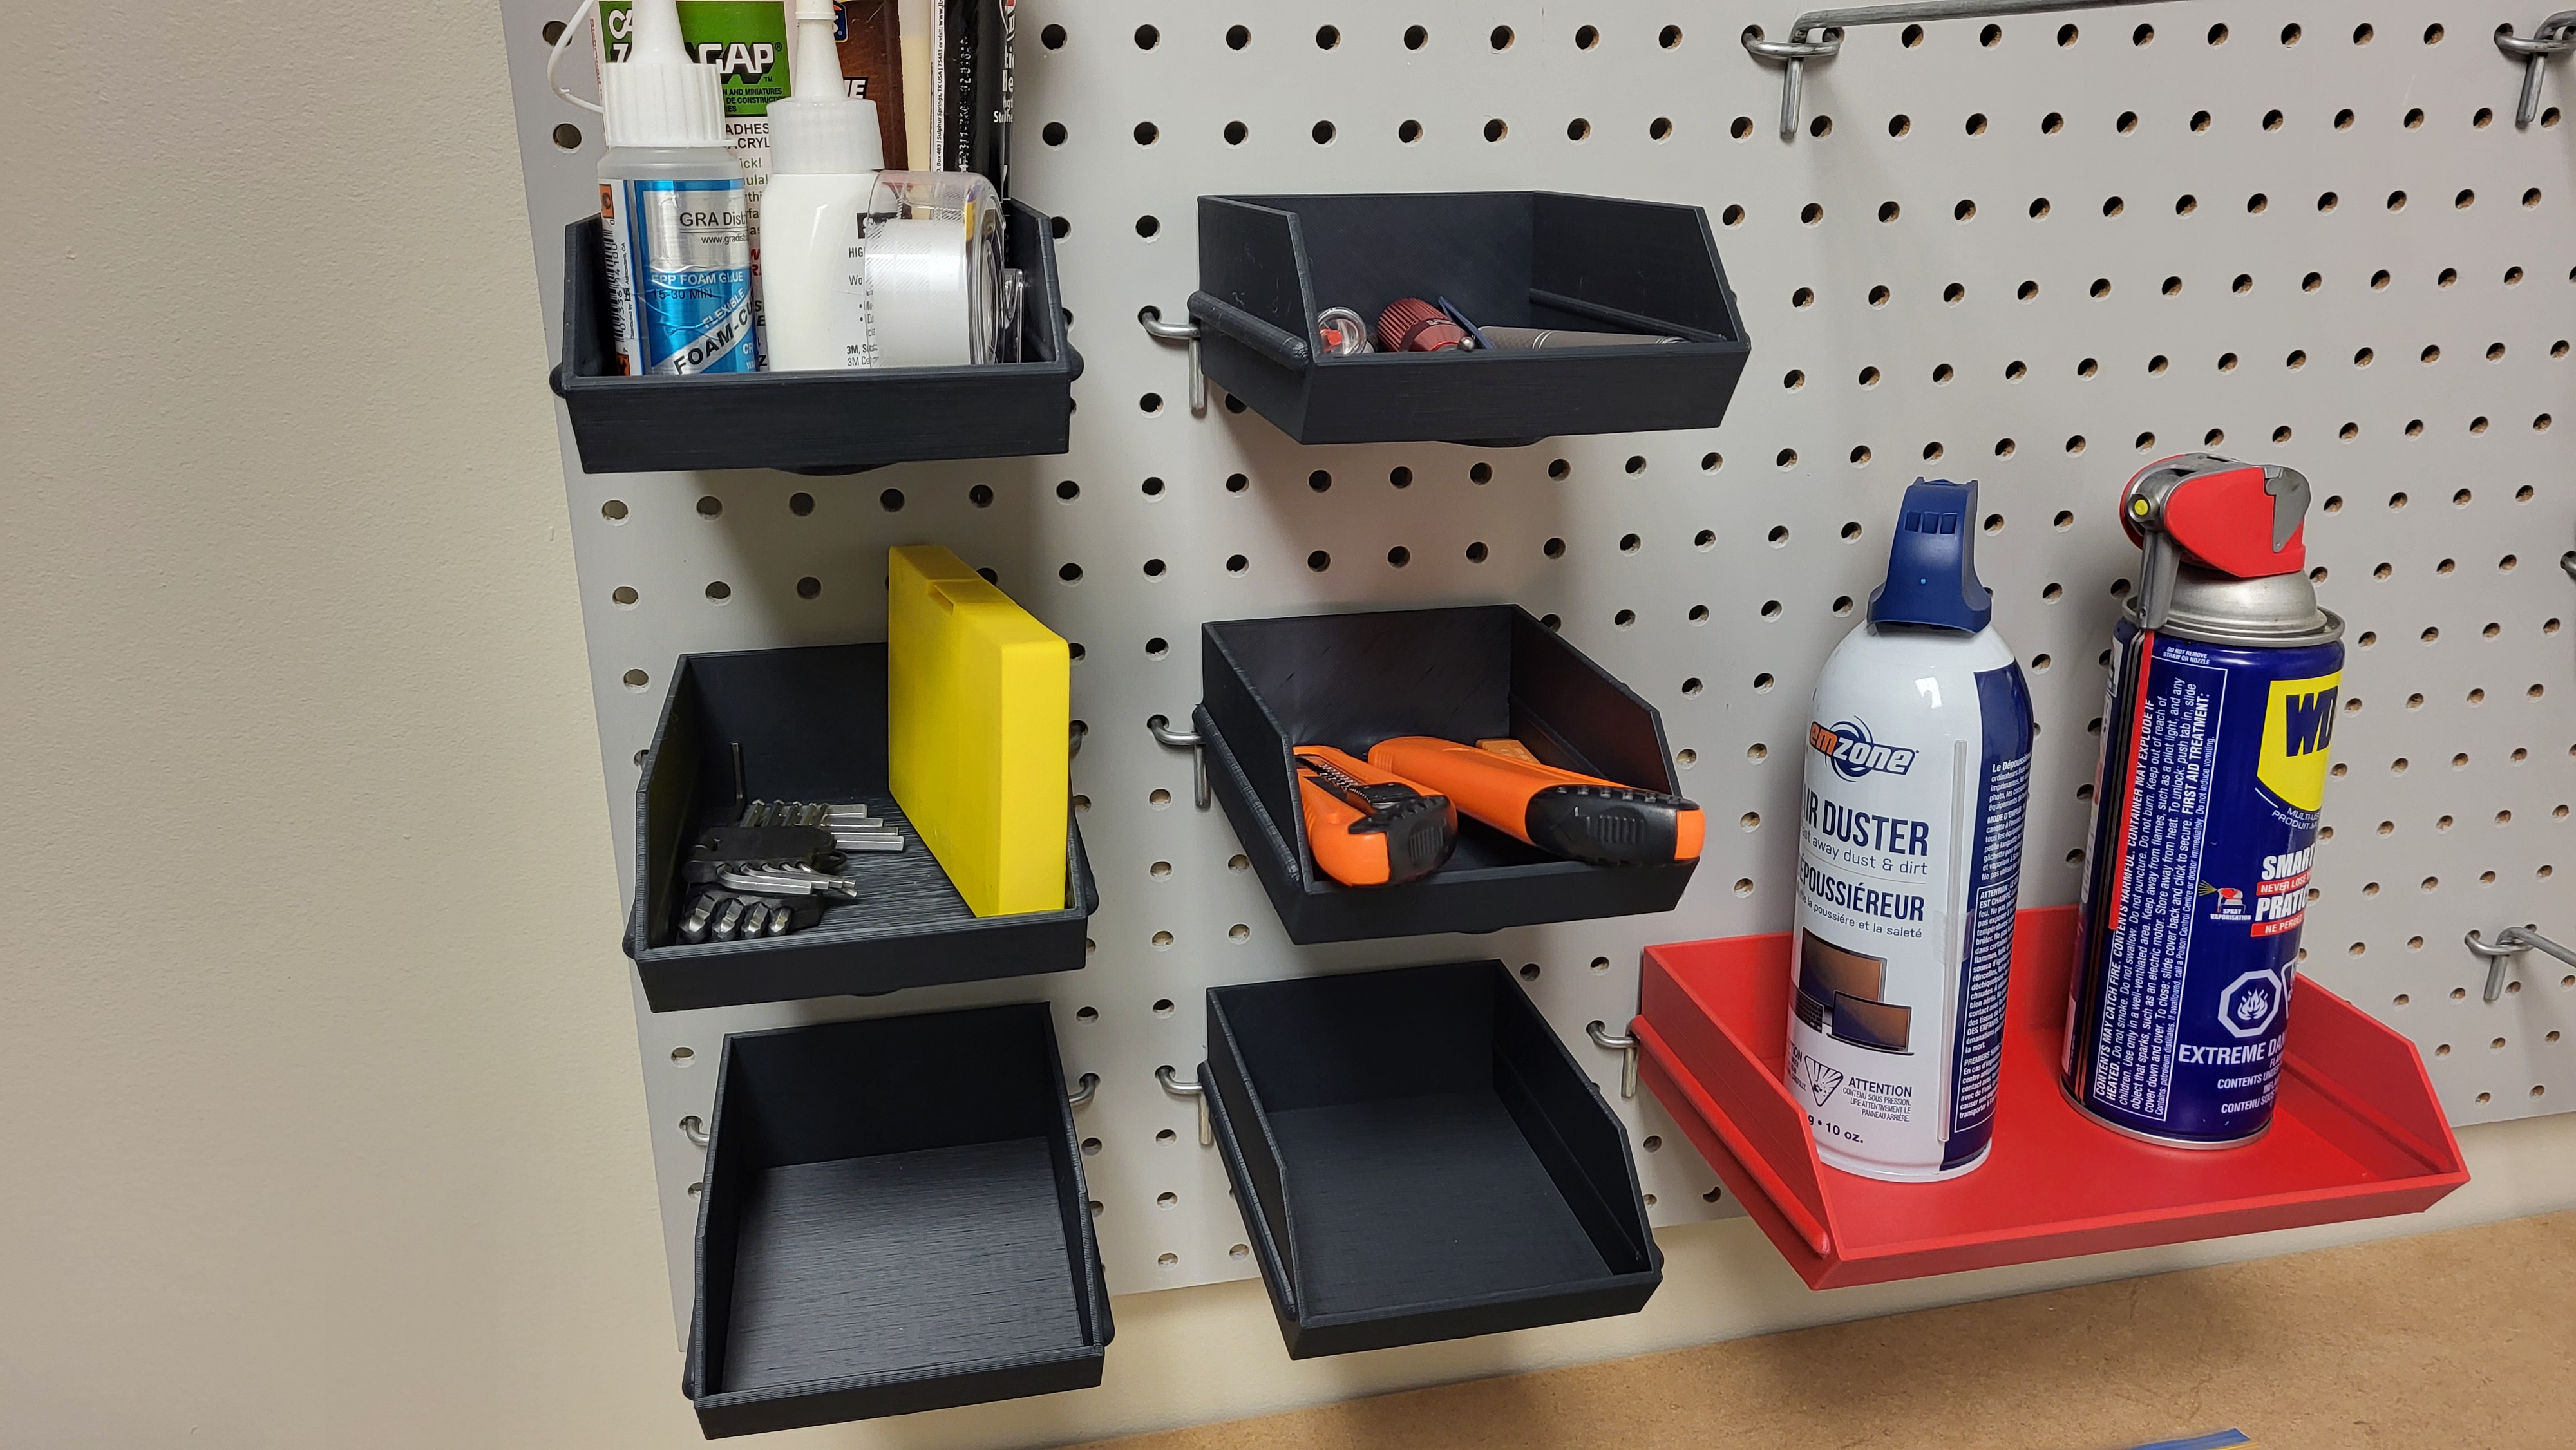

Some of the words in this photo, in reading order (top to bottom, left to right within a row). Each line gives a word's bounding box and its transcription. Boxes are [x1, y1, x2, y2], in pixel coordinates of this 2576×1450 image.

[679, 212, 719, 227] GRA
[680, 273, 717, 285] FOAM
[719, 271, 744, 283] GLUE
[617, 290, 626, 330] 07336
[702, 288, 745, 328] FLEXIBLE
[846, 345, 861, 355] 3M,
[848, 357, 859, 367] 3M
[2163, 652, 2181, 660] STRAW
[2190, 657, 2211, 665] NOZZLE
[2185, 650, 2208, 659] REMOVE
[2173, 677, 2185, 695] any
[2144, 699, 2154, 710] IF
[2157, 696, 2167, 706] of
[2170, 697, 2181, 715] and
[2155, 709, 2166, 735] reach
[2164, 719, 2179, 741] light,
[2188, 693, 2210, 760] TREATMENT:
[2286, 685, 2338, 757] WD
[2138, 712, 2153, 760] EXPLODE
[2152, 737, 2162, 747] of
[1810, 722, 1914, 773] emzone
[2151, 749, 2161, 764] out
[2163, 743, 2175, 764] pilot
[1992, 763, 2001, 773] Le
[2134, 762, 2146, 786] MAY
[2146, 767, 2160, 790] Keep
[2186, 763, 2200, 782] AID
[2161, 775, 2170, 786] as
[2143, 794, 2155, 816] burn.
[2157, 788, 2168, 810] such
[2181, 783, 2197, 814] FIRST
[1823, 799, 1929, 856] DUSTER
[1987, 814, 2003, 825] MODE
[2127, 788, 2143, 847] CONTAINER
[2142, 818, 2152, 833] not
[2151, 813, 2166, 845] flames,
[2179, 818, 2193, 851] secure.
[2138, 835, 2149, 848] Do
[1812, 837, 1839, 860] away
[1843, 849, 1877, 869] dust
[1882, 858, 1894, 871] &
[1899, 860, 1928, 875] dirt
[2148, 848, 2161, 869] from
[2176, 853, 2188, 862] to
[2261, 843, 2316, 880] SMART
[2120, 851, 2136, 903] HARMFUL.
[2135, 852, 2147, 894] puncture.
[2146, 871, 2159, 896] away
[2173, 864, 2186, 886] click
[2260, 881, 2290, 893] NEVER
[2291, 875, 2306, 888] LOSE
[1979, 899, 1990, 909] EST
[2132, 894, 2141, 910] not
[2172, 887, 2183, 905] and
[1807, 895, 1813, 909] la
[1859, 921, 1870, 931] et
[1873, 922, 1882, 934] la
[1886, 925, 1922, 939] saleté
[2128, 911, 2139, 924] Do
[2141, 898, 2155, 920] Keep
[2166, 907, 2181, 929] back
[1977, 918, 1988, 929] pas
[2113, 905, 2128, 957] CONTENTS
[2140, 923, 2151, 945] area.
[2265, 923, 2278, 934] NE
[2125, 927, 2137, 965] swallow.
[2166, 930, 2177, 956] cover
[2110, 961, 2121, 986] FIRE.
[2123, 965, 2132, 981] not
[2131, 945, 2148, 1010] well-ventilated
[2161, 957, 2174, 979] slide
[2119, 982, 2130, 995] Do
[2157, 981, 2170, 1006] close:
[2105, 986, 2117, 1020] CATCH
[2117, 998, 2128, 1028] smoke.
[2154, 1008, 2166, 1019] To
[1967, 1018, 1979, 1027] des
[2102, 1020, 2113, 1044] MAY
[2127, 1020, 2138, 1029] in
[2115, 1029, 2125, 1044] not
[2126, 1030, 2138, 1049] only
[2154, 1023, 2164, 1044] over.
[2112, 1045, 2122, 1059] Do
[2122, 1050, 2134, 1066] Use
[2151, 1045, 2161, 1062] and
[2178, 1042, 2266, 1065] EXTREME
[1964, 1067, 1971, 1075] En
[1971, 1064, 1982, 1073] cas
[2096, 1044, 2110, 1096] CONTENTS
[2146, 1064, 2159, 1088] down
[1848, 1077, 1913, 1097] ATTENTION
[2106, 1061, 2120, 1101] HEATED.
[2118, 1070, 2132, 1106] children.
[2217, 1073, 2262, 1089] CONTENTS
[1843, 1087, 1867, 1100] CONTENU
[1868, 1093, 1883, 1103] SOUS
[1850, 1097, 1861, 1106] LIRE
[1862, 1100, 1902, 1114] ATTENTIVEMENT
[2143, 1088, 2155, 1113] cover
[2221, 1097, 2260, 1113] CONTENU
[1861, 1108, 1886, 1120] PANNEAU
[1826, 1122, 1841, 1136] 10
[1844, 1131, 1864, 1144] oz.
